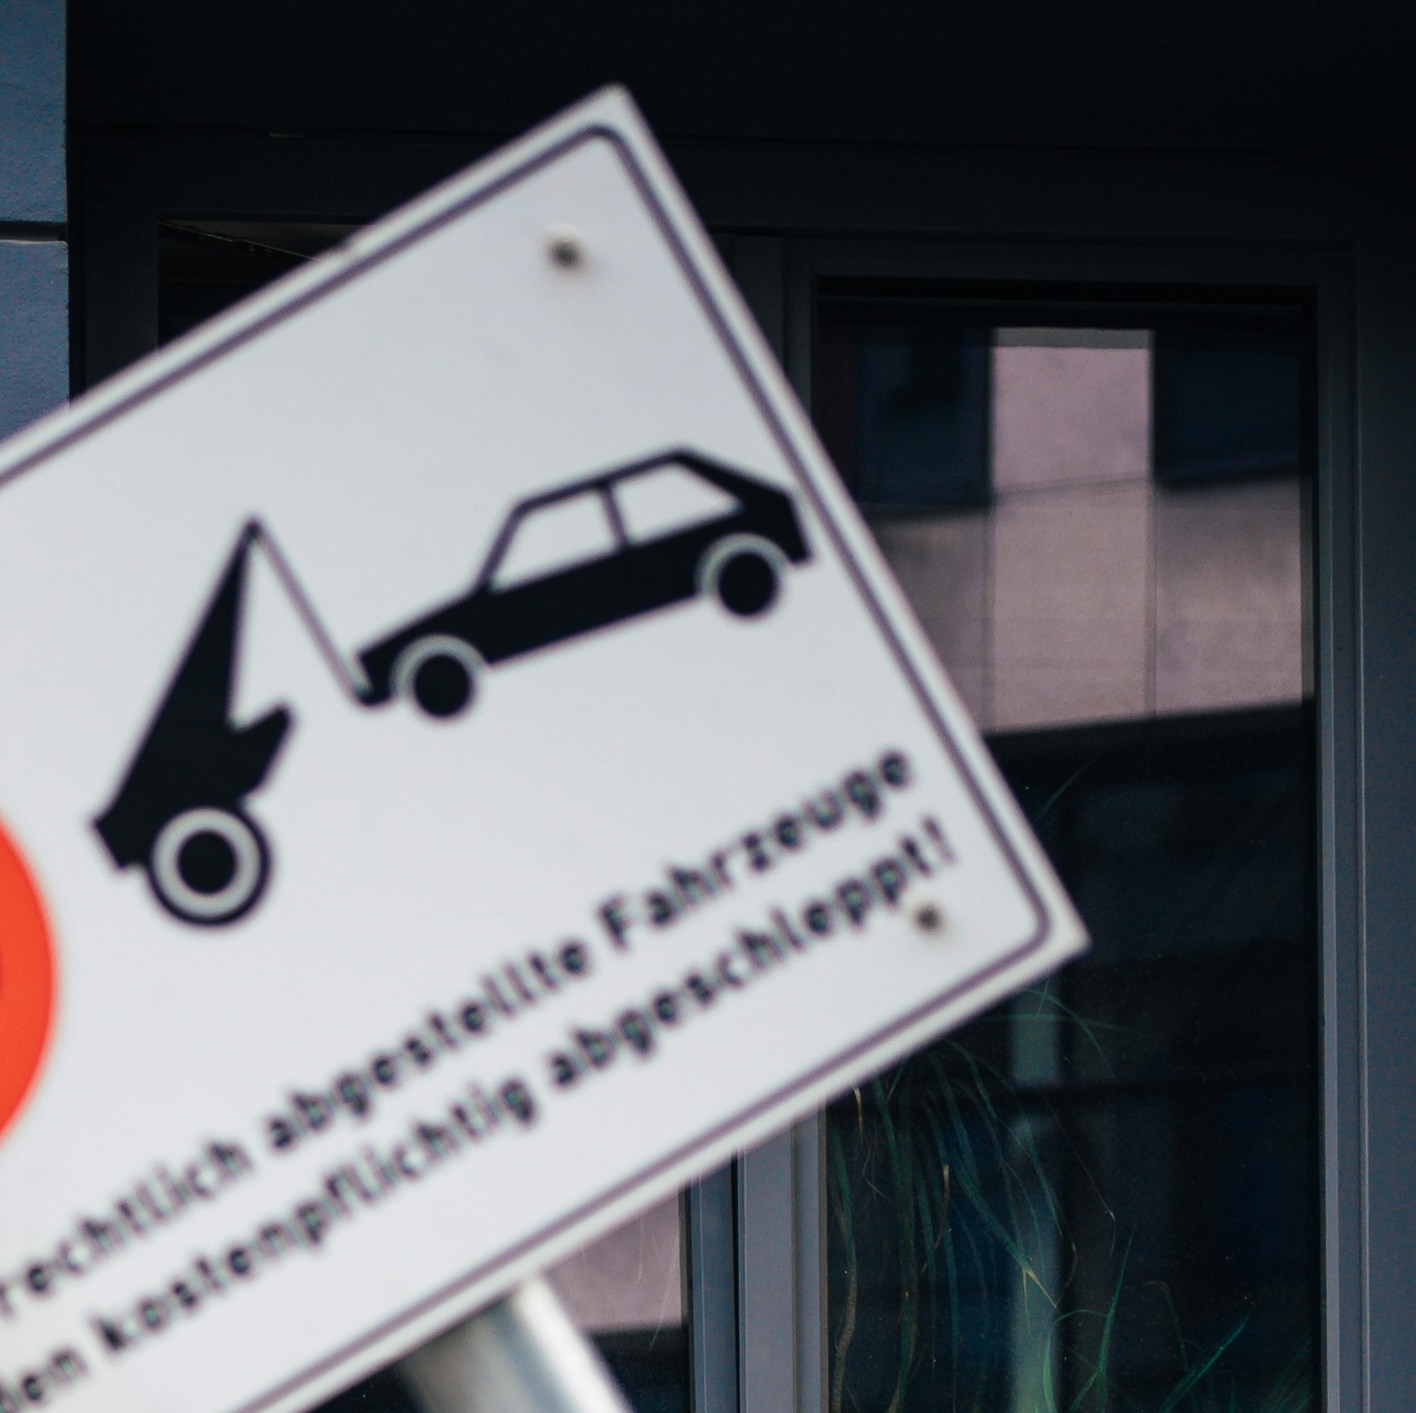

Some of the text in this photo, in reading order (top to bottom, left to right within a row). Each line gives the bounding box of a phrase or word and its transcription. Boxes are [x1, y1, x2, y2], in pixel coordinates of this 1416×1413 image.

[99, 1076, 539, 1355] kostenpflichtig
[547, 816, 958, 1092] abgeschleppt!
[262, 935, 592, 1158] abgestellte
[596, 745, 914, 955] Fahrzeuge
